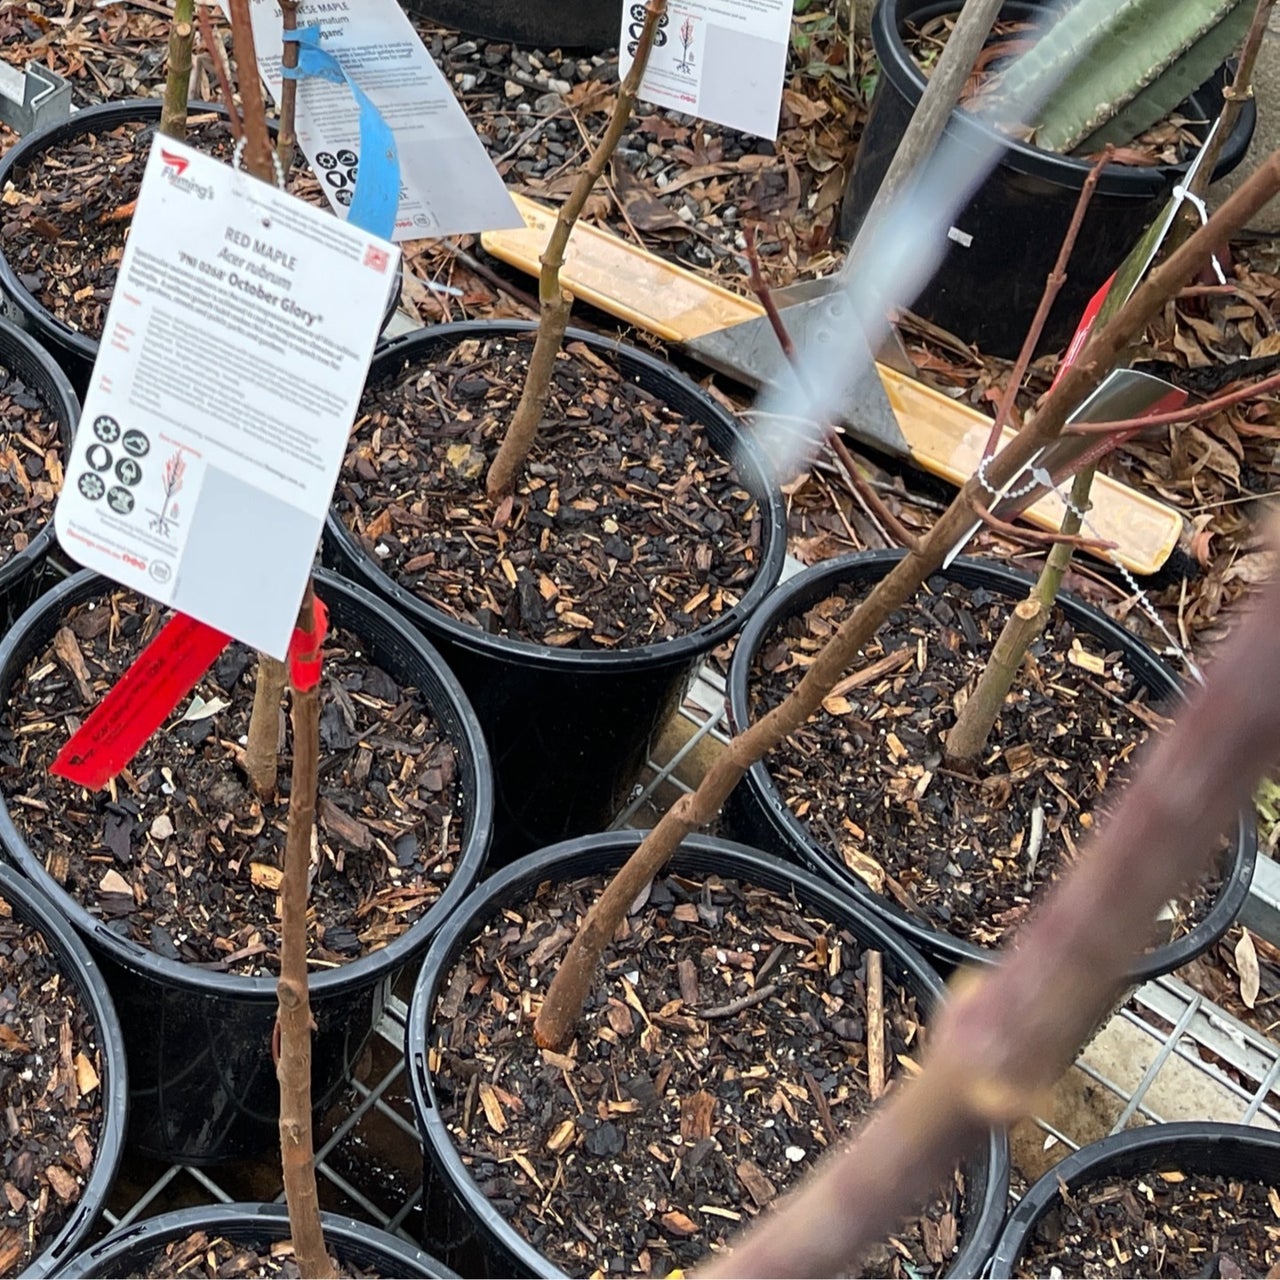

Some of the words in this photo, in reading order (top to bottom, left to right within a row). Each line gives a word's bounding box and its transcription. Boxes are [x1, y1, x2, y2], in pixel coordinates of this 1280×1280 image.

[319, 1, 350, 13] MAPLE
[225, 226, 251, 249] RED
[252, 240, 297, 272] MAPLE
[217, 247, 245, 268] Acer
[244, 260, 293, 291] rubrum
[228, 272, 280, 307] October
